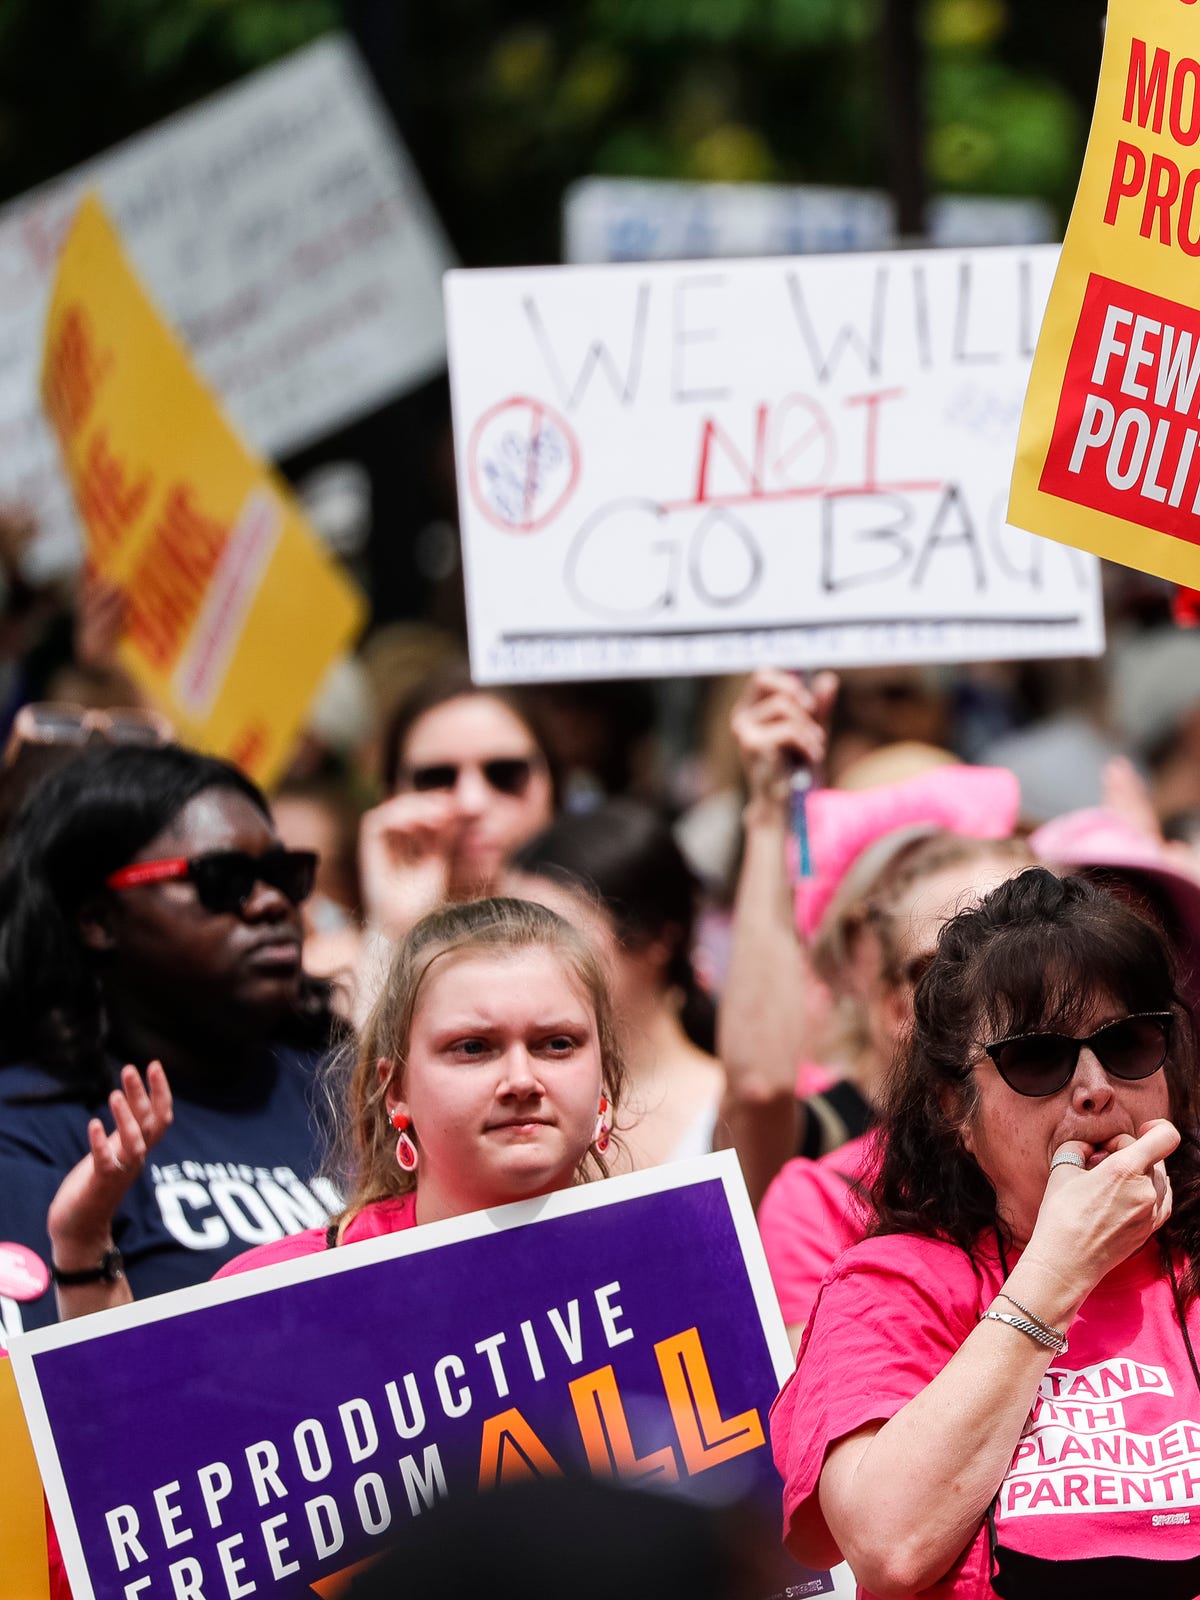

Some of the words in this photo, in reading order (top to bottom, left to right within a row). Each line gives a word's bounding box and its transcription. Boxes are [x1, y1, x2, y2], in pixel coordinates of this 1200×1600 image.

[520, 272, 732, 410] WE
[564, 497, 764, 622] GO
[104, 1281, 634, 1572] REPRODUCTIVE
[477, 1326, 767, 1494] ALL
[1037, 1362, 1164, 1399] TAND
